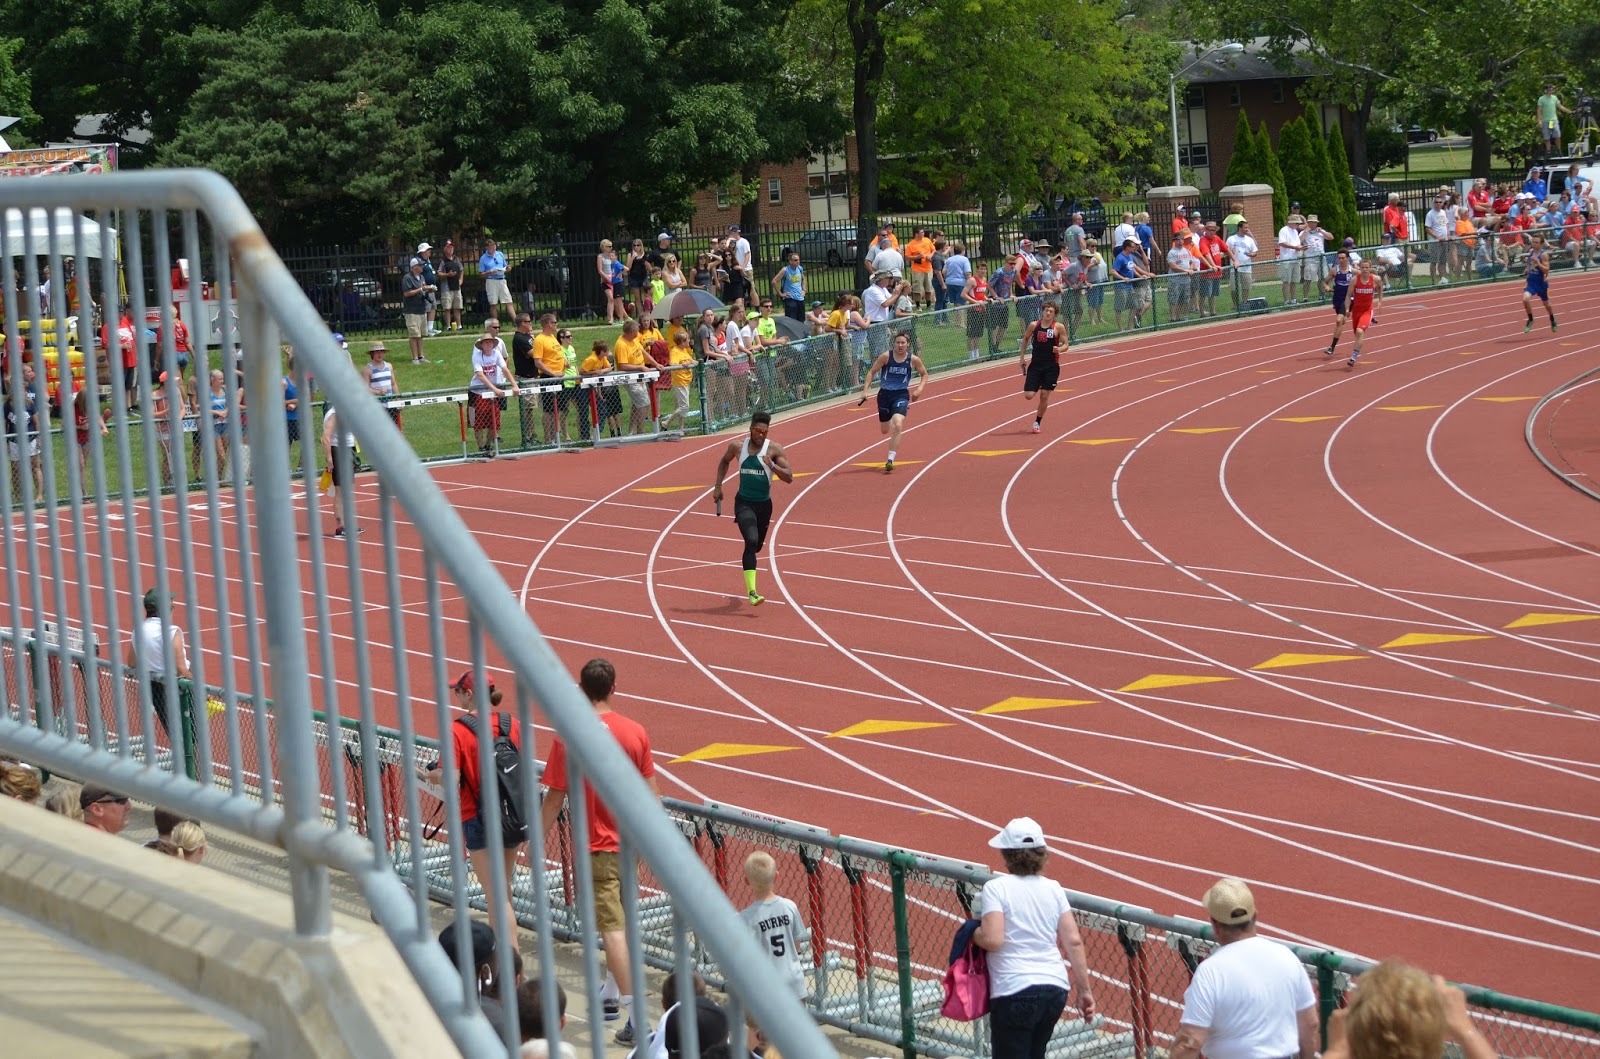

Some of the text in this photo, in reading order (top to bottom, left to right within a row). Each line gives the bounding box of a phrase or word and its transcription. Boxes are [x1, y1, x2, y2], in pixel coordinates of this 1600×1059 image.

[7, 148, 90, 165] NATURAL
[1047, 329, 1054, 338] 6
[419, 397, 438, 405] UCS
[758, 914, 791, 933] BURNS
[770, 934, 786, 957] 5
